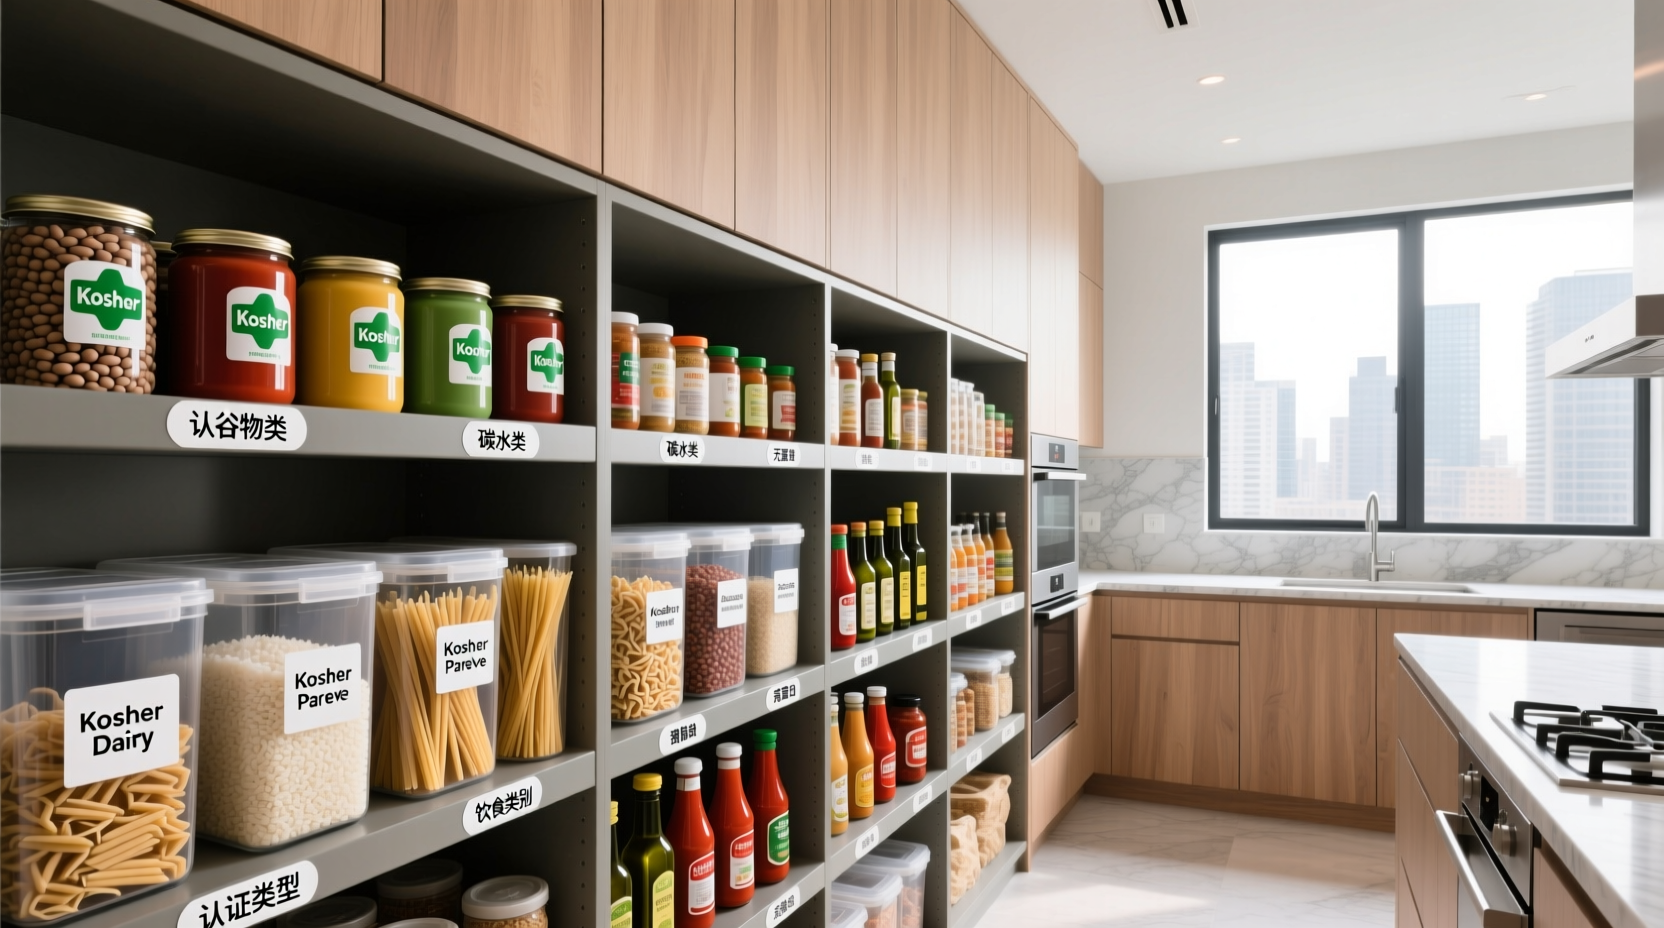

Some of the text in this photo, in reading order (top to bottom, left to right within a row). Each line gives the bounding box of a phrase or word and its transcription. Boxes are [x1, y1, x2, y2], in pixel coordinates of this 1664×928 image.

[77, 286, 141, 312] Kosher
[237, 309, 288, 331] Kosher
[189, 410, 287, 442] 认谷物类
[444, 638, 489, 657] Kosher
[445, 656, 487, 674] Pareve
[295, 667, 352, 690] Kosher
[298, 689, 349, 710] Pareve
[80, 705, 164, 733] Kosher
[93, 729, 154, 756] Dairy
[199, 871, 301, 928] 认证类型
